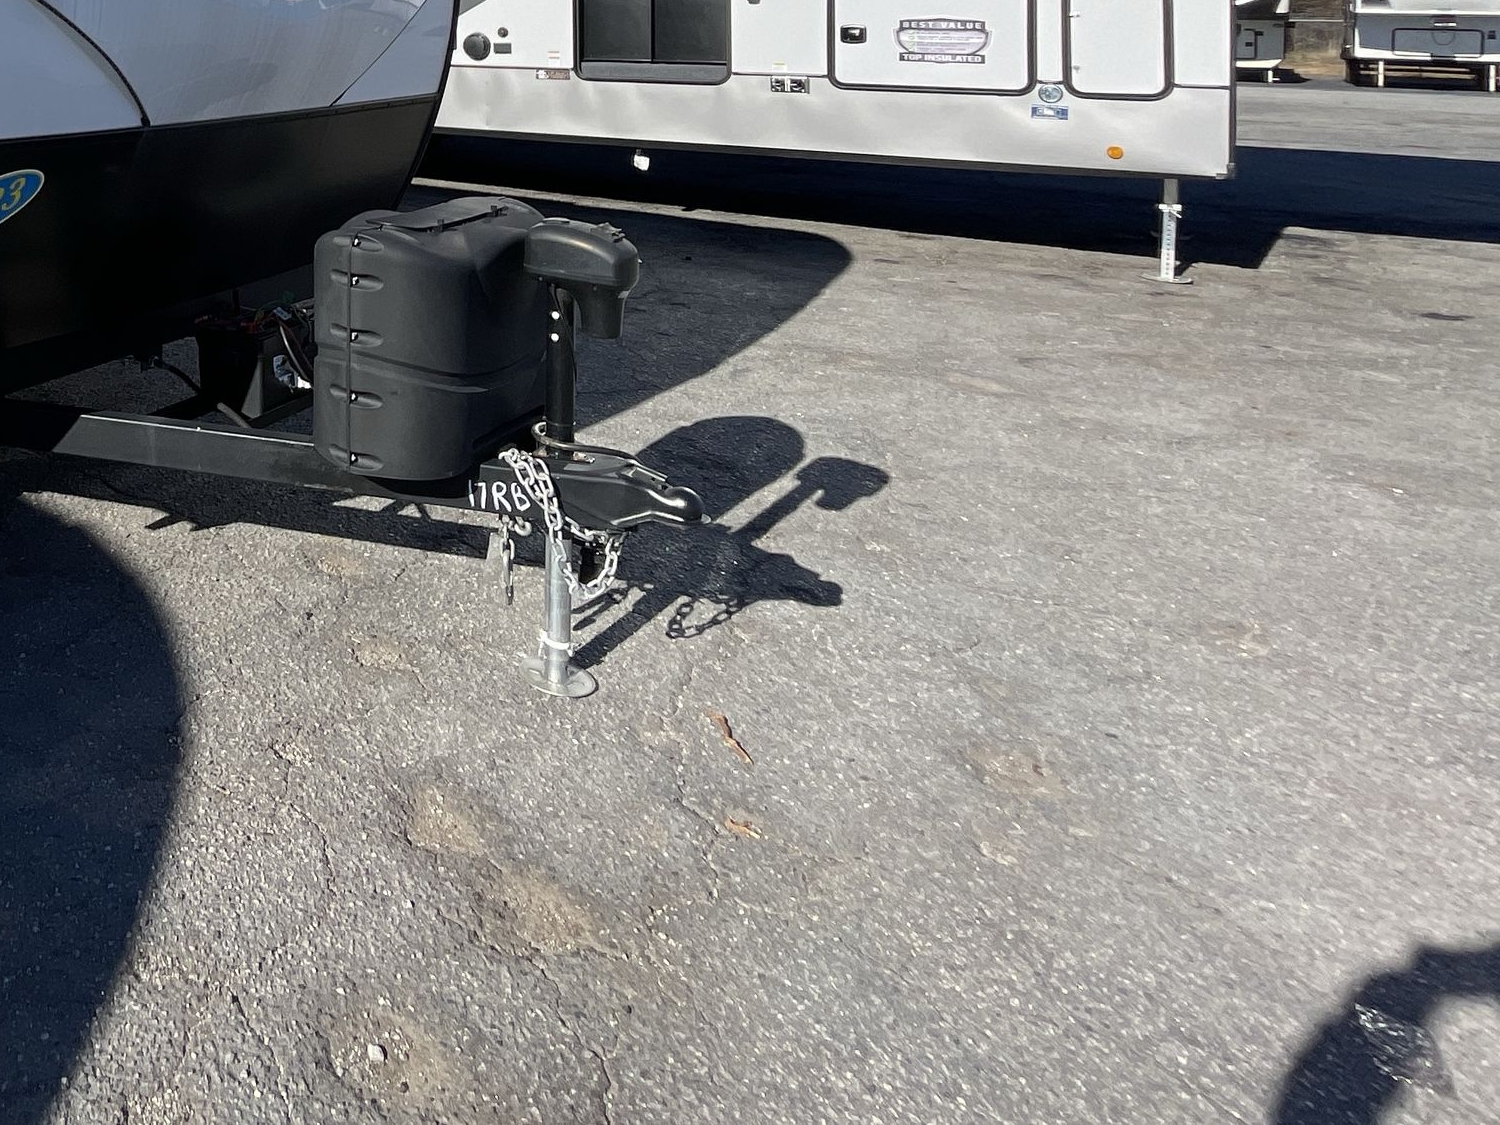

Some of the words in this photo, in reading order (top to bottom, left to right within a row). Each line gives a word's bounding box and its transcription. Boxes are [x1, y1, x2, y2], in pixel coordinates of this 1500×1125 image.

[940, 21, 983, 30] VALUE
[902, 53, 922, 61] TOP
[924, 54, 982, 63] INSULATED
